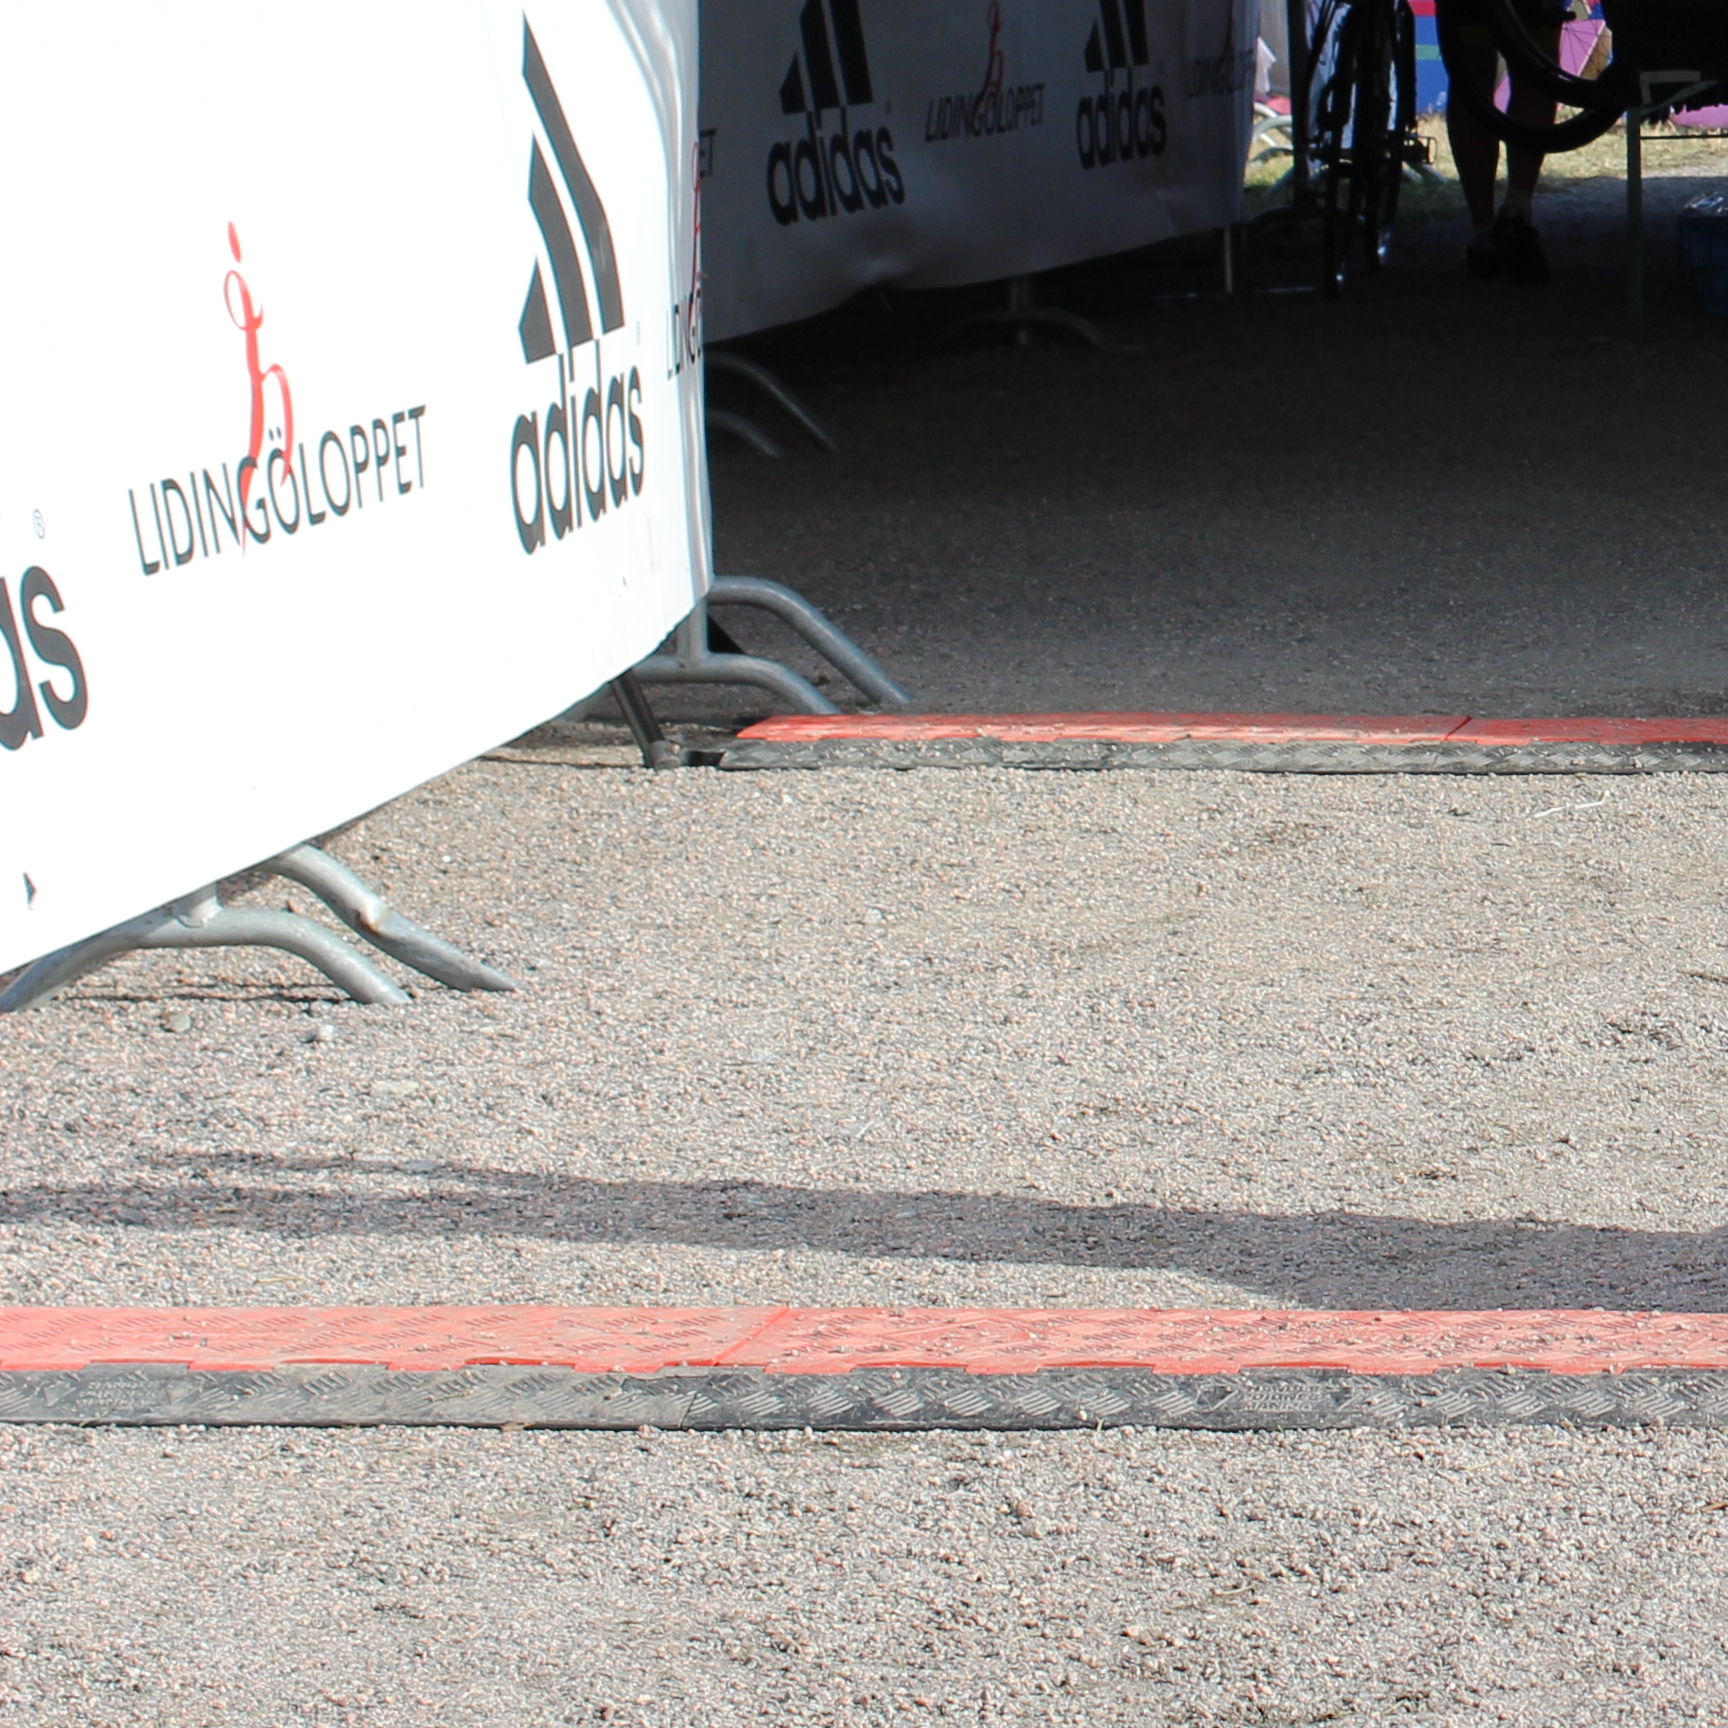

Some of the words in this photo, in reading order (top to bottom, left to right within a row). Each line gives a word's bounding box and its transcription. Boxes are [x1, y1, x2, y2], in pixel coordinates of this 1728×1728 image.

[766, 106, 905, 227] adidas
[1076, 68, 1167, 170] adidas
[128, 404, 427, 577] LIDINGÖLOPPET
[510, 334, 646, 555] adidas
